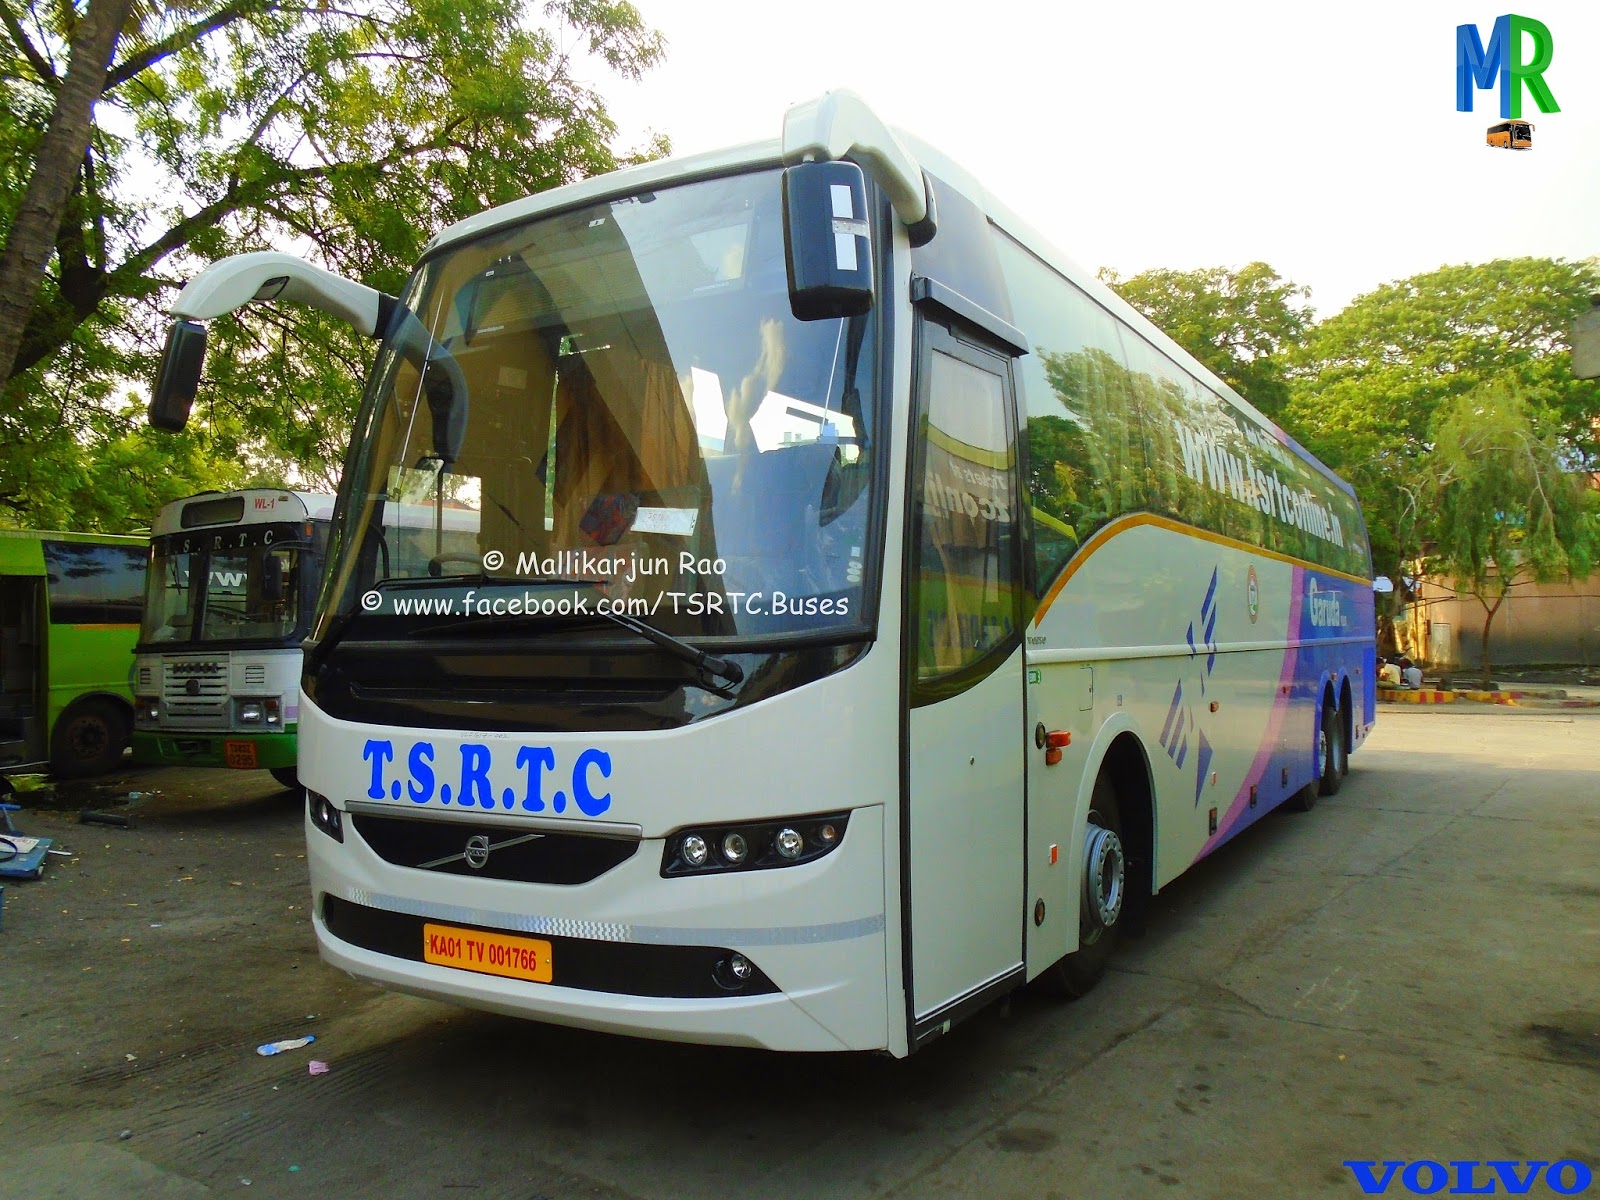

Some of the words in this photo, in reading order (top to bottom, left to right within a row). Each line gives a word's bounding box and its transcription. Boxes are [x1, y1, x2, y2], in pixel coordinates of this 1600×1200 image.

[254, 498, 275, 509] WL-1
[363, 739, 612, 817] T.S.R.T.C
[430, 934, 461, 959] KA01
[466, 940, 484, 962] TV
[488, 944, 537, 971] 001766
